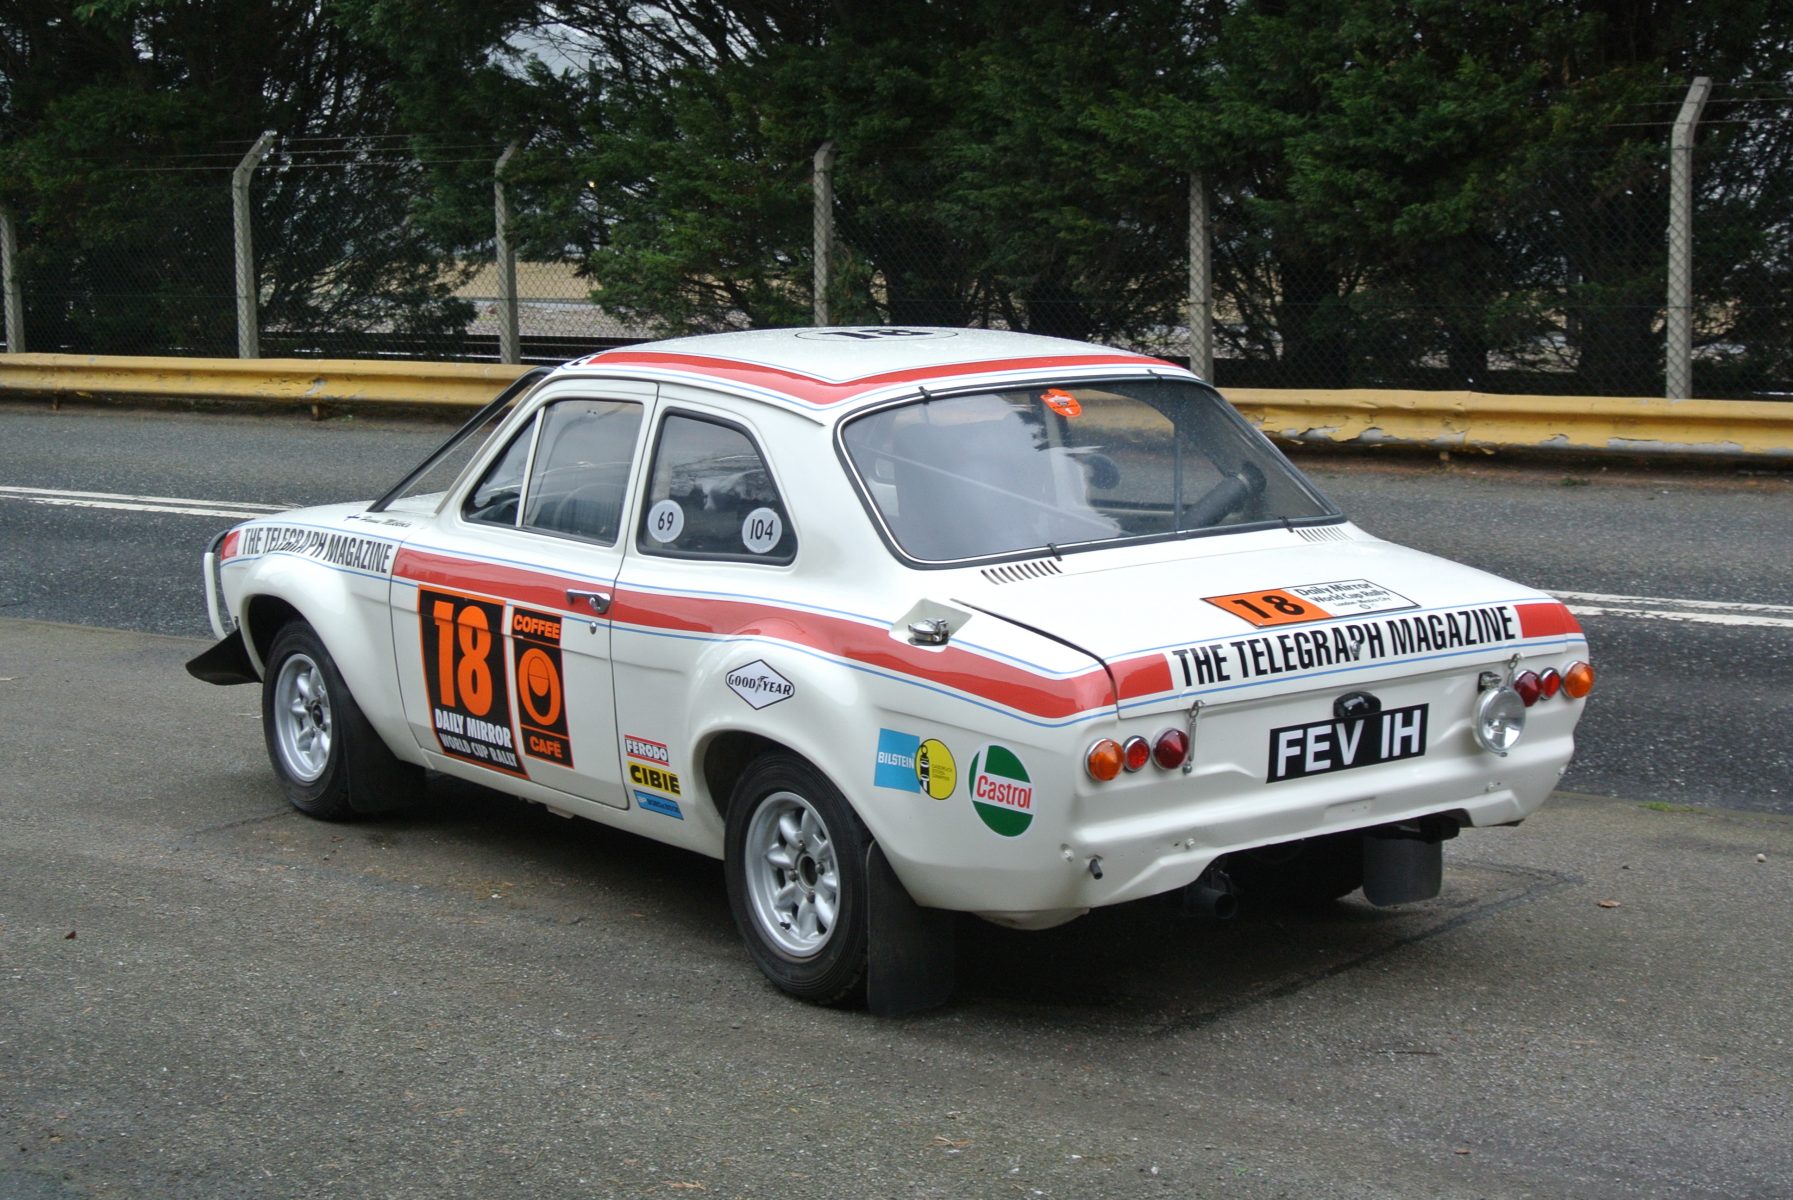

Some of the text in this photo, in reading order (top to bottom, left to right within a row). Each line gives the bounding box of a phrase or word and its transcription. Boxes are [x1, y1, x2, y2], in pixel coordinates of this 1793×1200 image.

[656, 511, 674, 531] 69
[750, 519, 774, 541] 104
[242, 527, 394, 574] THE TELEGRAPH MAGAZINE
[1294, 583, 1373, 596] Daily Mirror
[1231, 595, 1305, 619] 18
[513, 614, 560, 639] COFFEE
[433, 600, 493, 717] 18
[1173, 605, 1517, 687] THE TELEGRAPH MAGAZINE
[435, 708, 513, 749] DAILY MIRROR
[439, 733, 518, 768] WORLD CUP RALLY
[625, 739, 668, 762] FERODO
[878, 751, 915, 769] BILSTEIN
[1276, 718, 1365, 778] FEV
[976, 775, 1032, 809] Castrol
